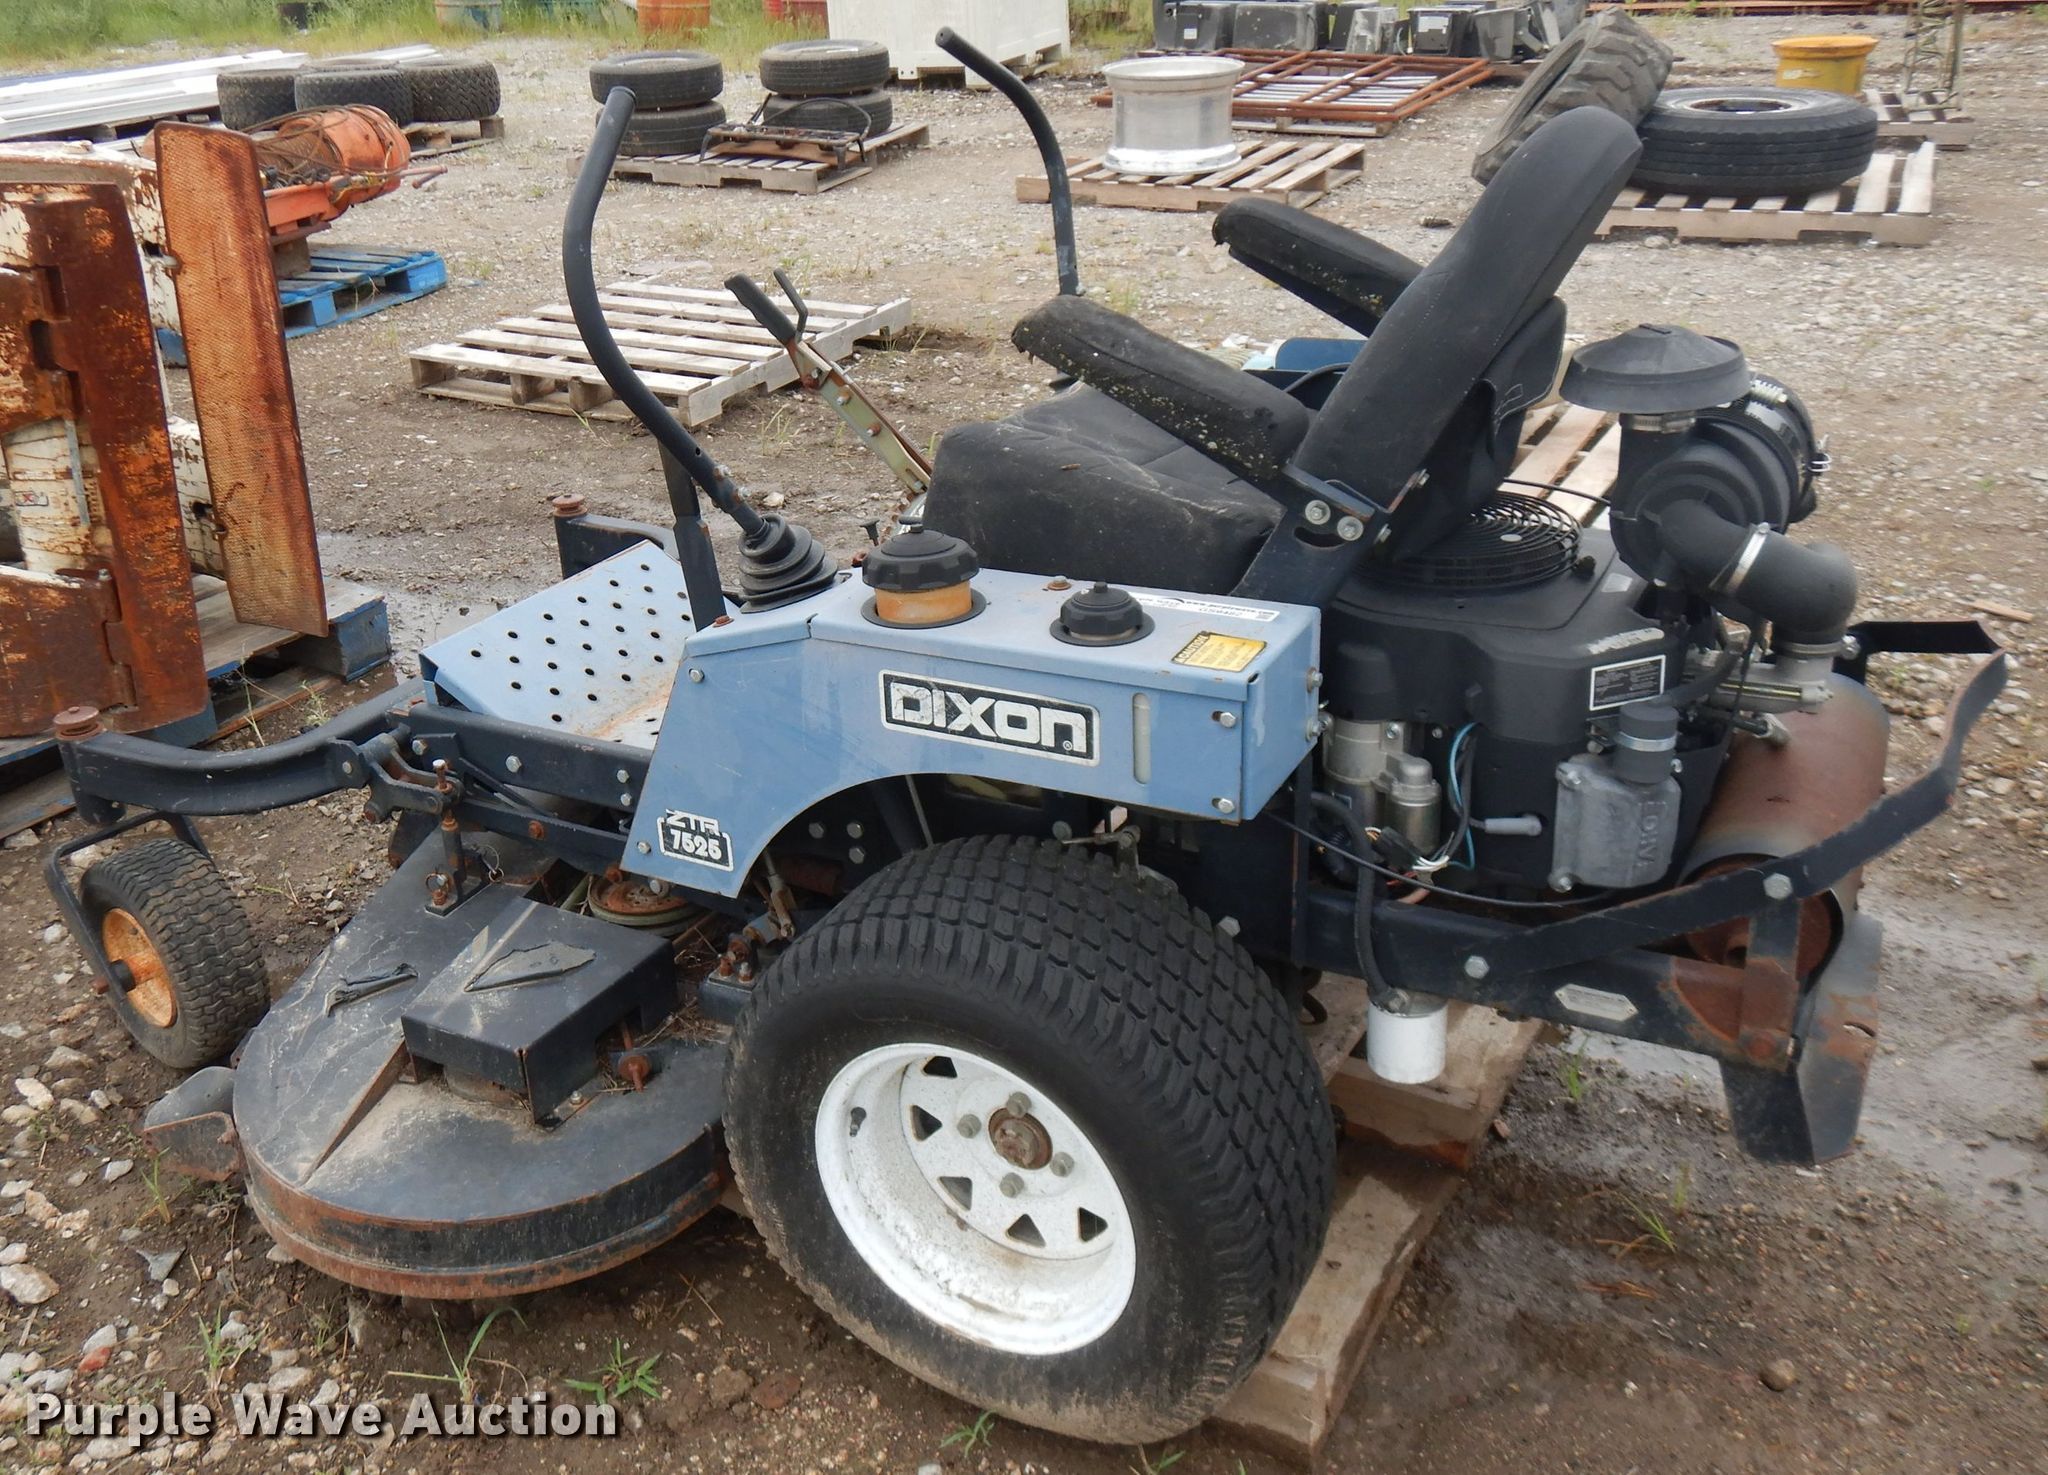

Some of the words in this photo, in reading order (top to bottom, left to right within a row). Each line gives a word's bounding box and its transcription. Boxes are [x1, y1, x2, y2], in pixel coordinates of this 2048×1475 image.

[889, 682, 1088, 754] DIXON
[665, 808, 721, 836] ZTR
[670, 828, 722, 860] 7525
